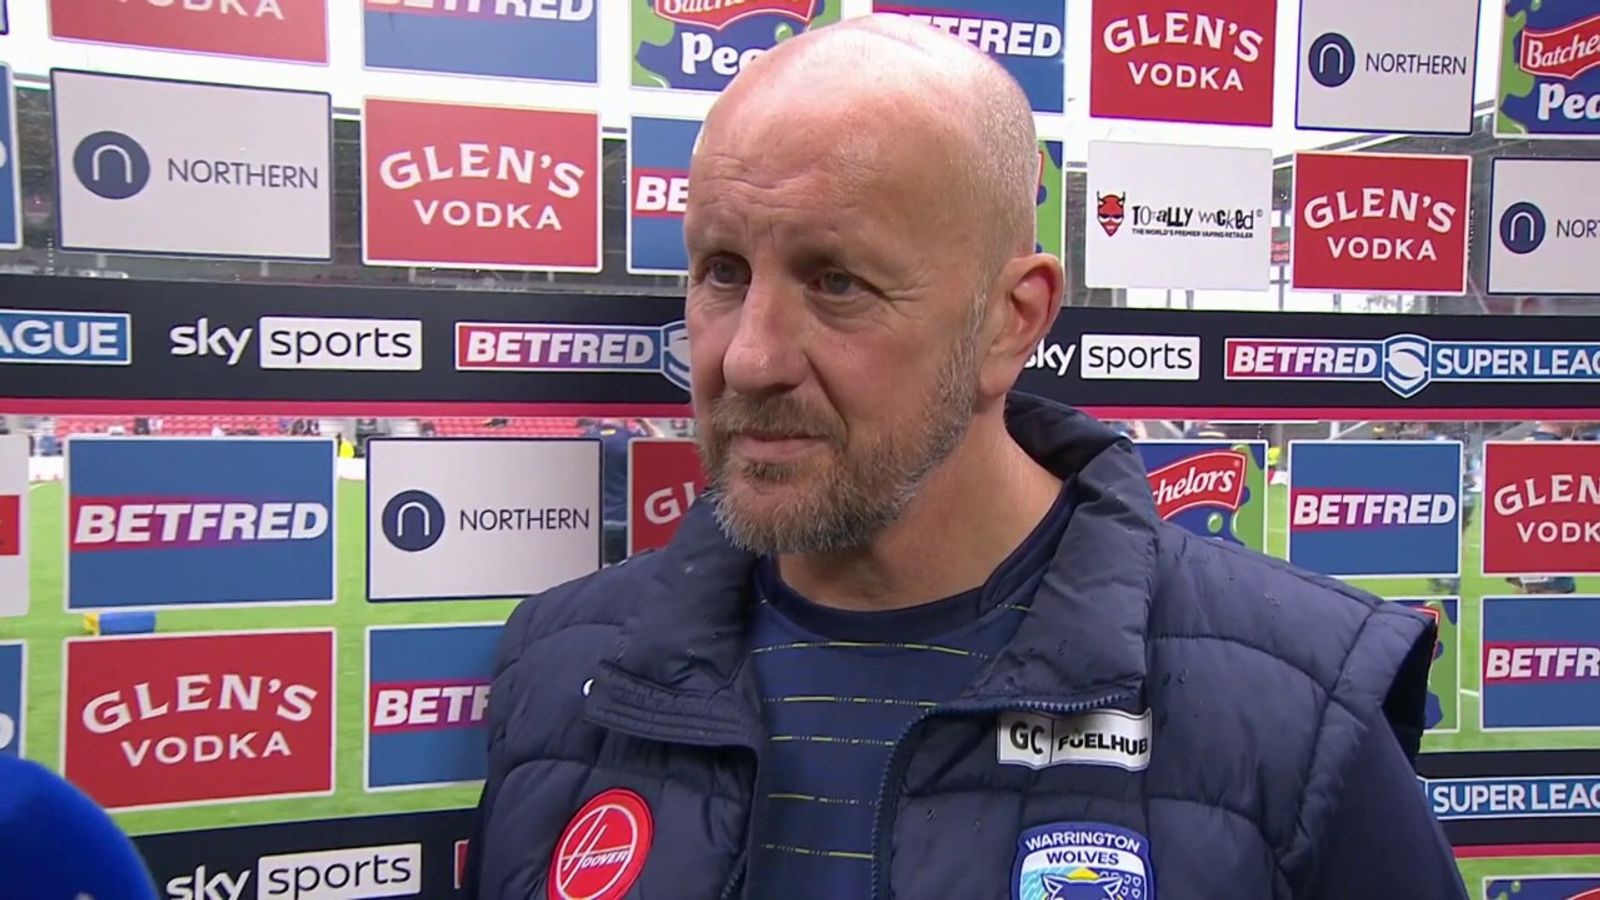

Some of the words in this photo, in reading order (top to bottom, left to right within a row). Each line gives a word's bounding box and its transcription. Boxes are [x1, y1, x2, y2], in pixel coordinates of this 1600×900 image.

[1104, 12, 1263, 62] GLEN'S
[1128, 62, 1244, 91] VODKA
[1366, 52, 1467, 76] NORTHERN
[167, 157, 318, 190] NORTHERN
[379, 143, 585, 198] GLEN'S
[414, 200, 563, 230] VODKA
[1304, 187, 1456, 233] GLEN'S
[1556, 219, 1600, 238] NOR
[1328, 237, 1437, 261] VODKA
[171, 318, 252, 365] sky
[271, 327, 412, 364] sports
[466, 331, 653, 364] BETFRED
[1088, 343, 1193, 375] sports
[1233, 345, 1377, 376] BETFRED
[1436, 348, 1527, 375] SUPER
[1153, 467, 1236, 505] helors
[75, 503, 328, 544] BETFRED
[460, 507, 590, 531] NORTHERN
[1294, 495, 1455, 525] BETFRED
[1517, 521, 1600, 543] VODK
[82, 673, 318, 735] GLEN'S
[120, 731, 291, 767] VODKA
[1010, 721, 1045, 755] GC
[1057, 732, 1149, 756] FUELHUB
[1433, 785, 1526, 813] SUPER
[1025, 831, 1140, 853] WARRINGTON
[1046, 850, 1119, 865] WOLVES
[166, 865, 252, 900] sky
[268, 852, 412, 898] sports
